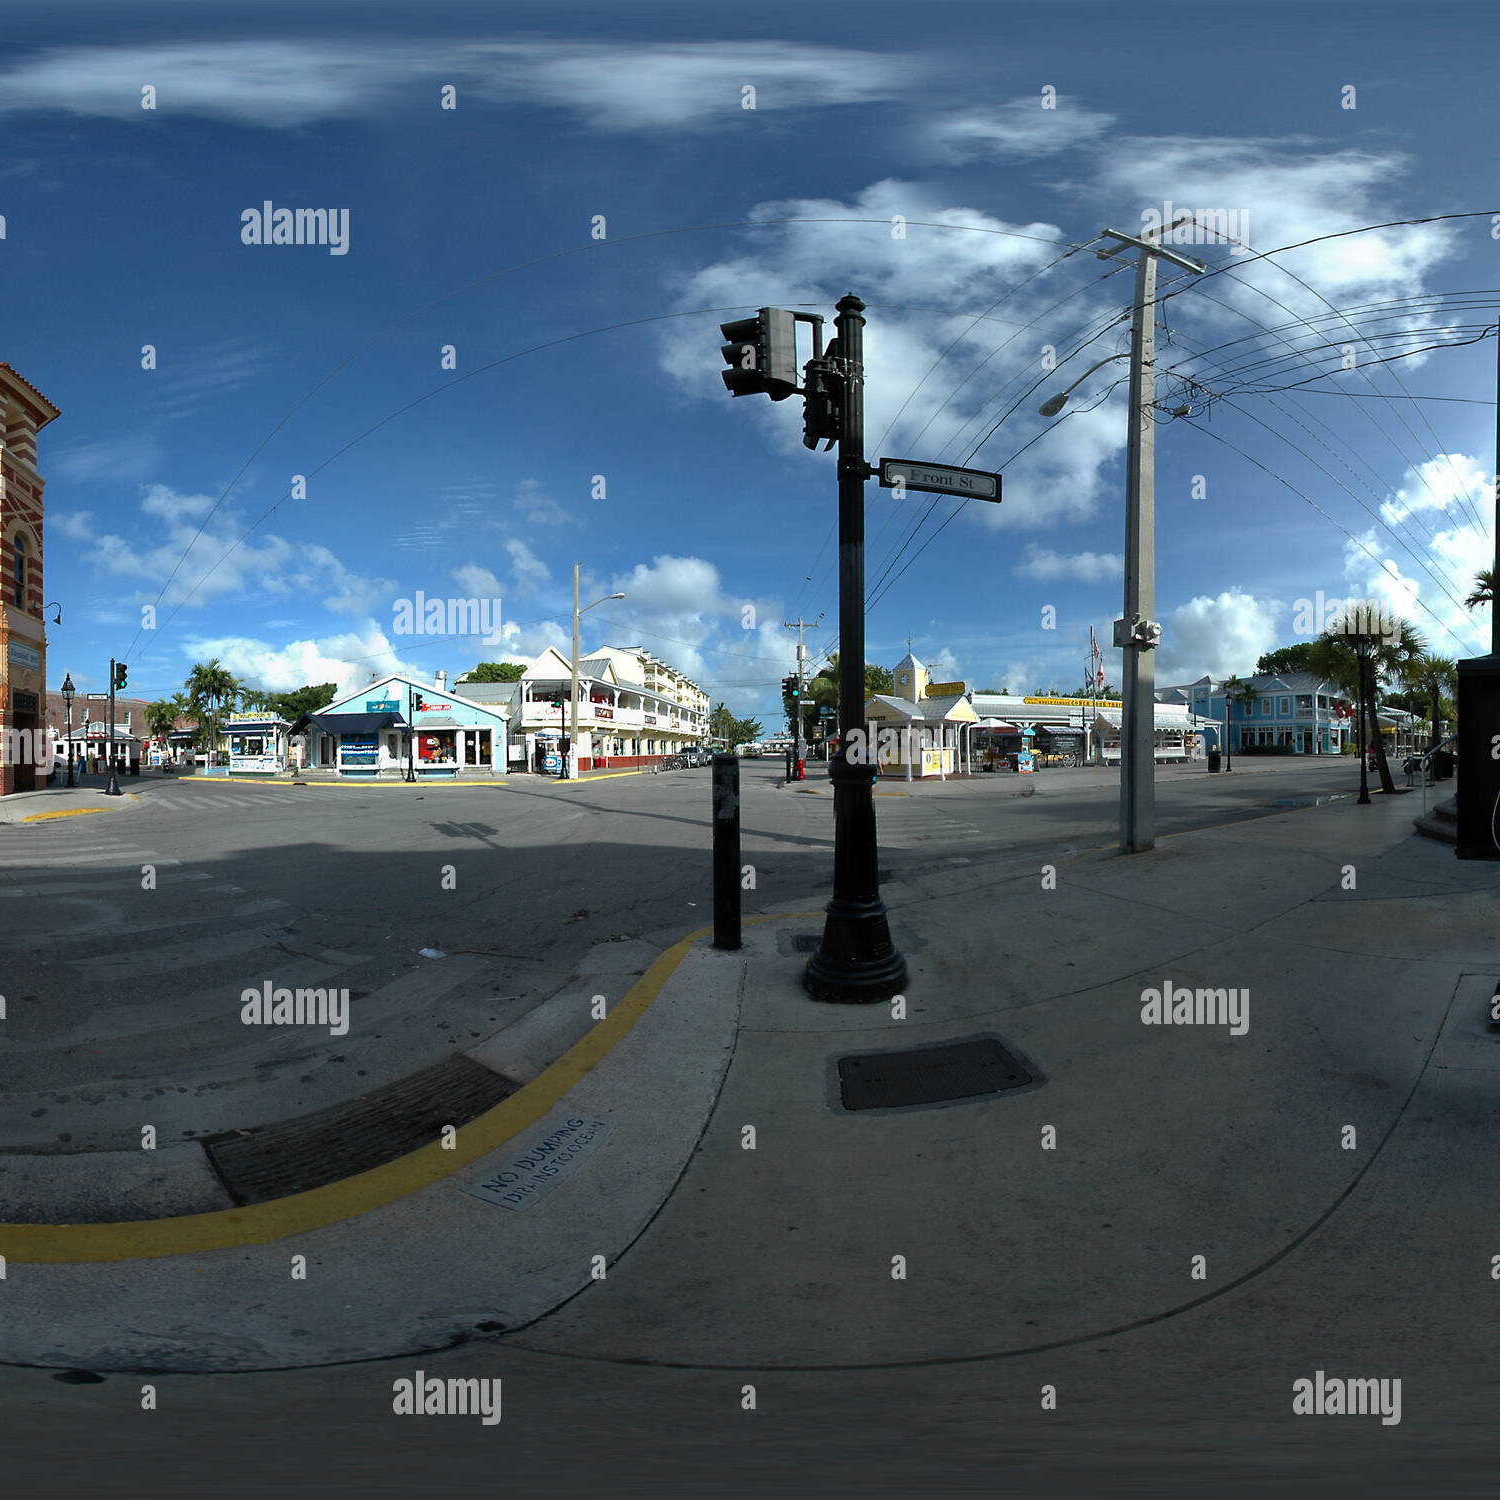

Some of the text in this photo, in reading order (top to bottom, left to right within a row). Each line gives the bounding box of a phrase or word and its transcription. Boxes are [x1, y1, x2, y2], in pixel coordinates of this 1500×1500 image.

[910, 469, 974, 489] Front St
[482, 1118, 584, 1193] NO DUMPING
